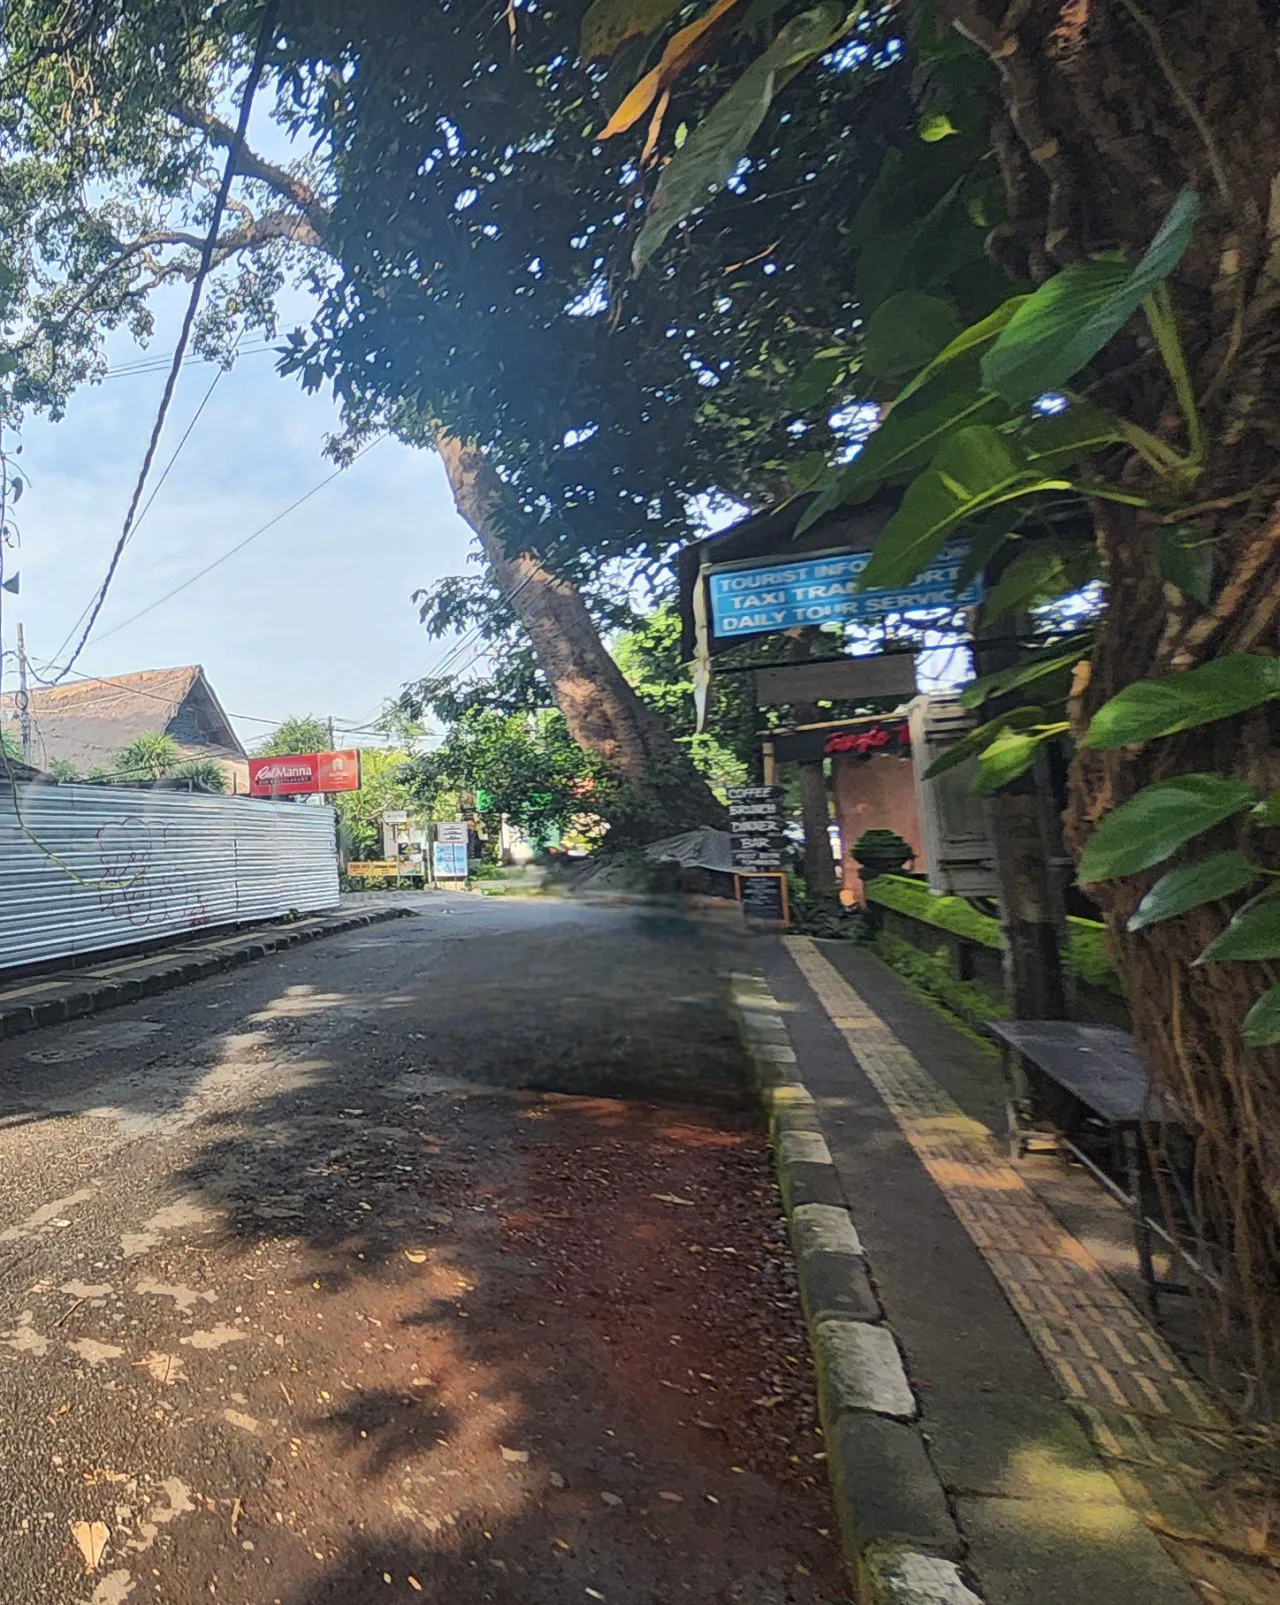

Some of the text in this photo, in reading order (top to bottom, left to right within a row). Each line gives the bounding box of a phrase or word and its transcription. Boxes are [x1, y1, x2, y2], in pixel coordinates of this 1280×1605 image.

[719, 567, 810, 592] TOURIST
[722, 610, 787, 631] DAILY
[864, 586, 977, 612] SERVICE
[729, 590, 786, 609] TAXI
[727, 787, 773, 799] COFFEE
[740, 837, 772, 849] BAR
